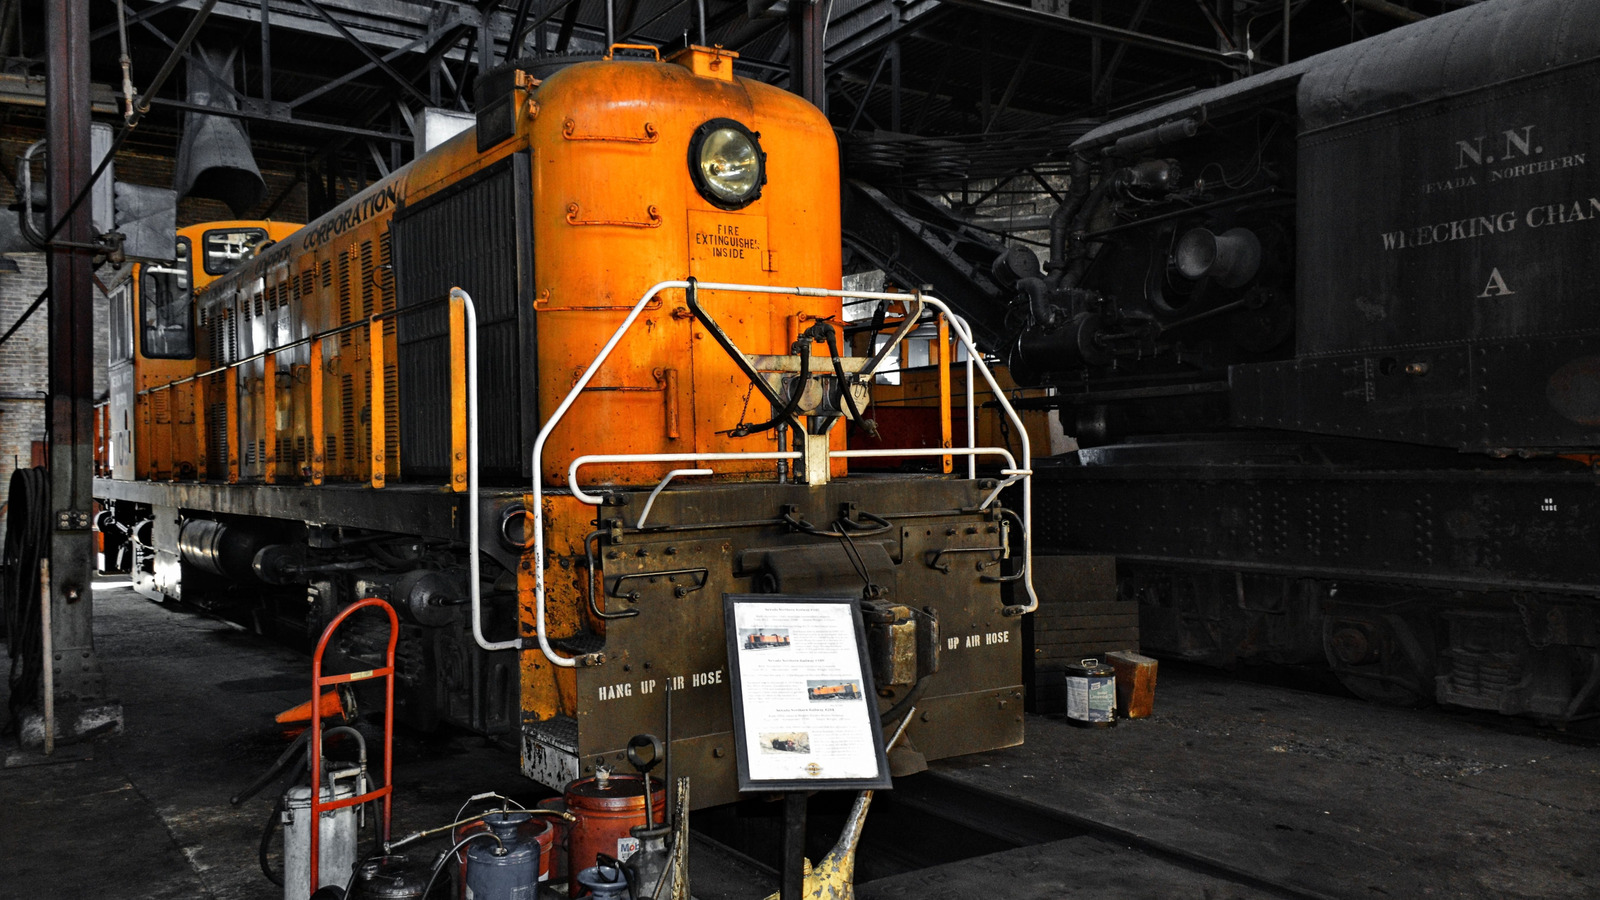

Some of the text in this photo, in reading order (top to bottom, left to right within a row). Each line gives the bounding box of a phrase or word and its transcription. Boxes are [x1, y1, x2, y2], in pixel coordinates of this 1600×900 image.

[1491, 153, 1586, 181] NORTHERN
[303, 181, 398, 250] CORPORATION
[718, 224, 739, 236] FIRE
[712, 247, 744, 259] INSIDE
[1476, 267, 1515, 298] A
[947, 637, 960, 650] UP
[965, 634, 981, 648] AIR
[985, 630, 1009, 645] HOSE
[598, 683, 632, 701] HANG
[640, 679, 656, 695] UP
[692, 670, 722, 688] HOSE
